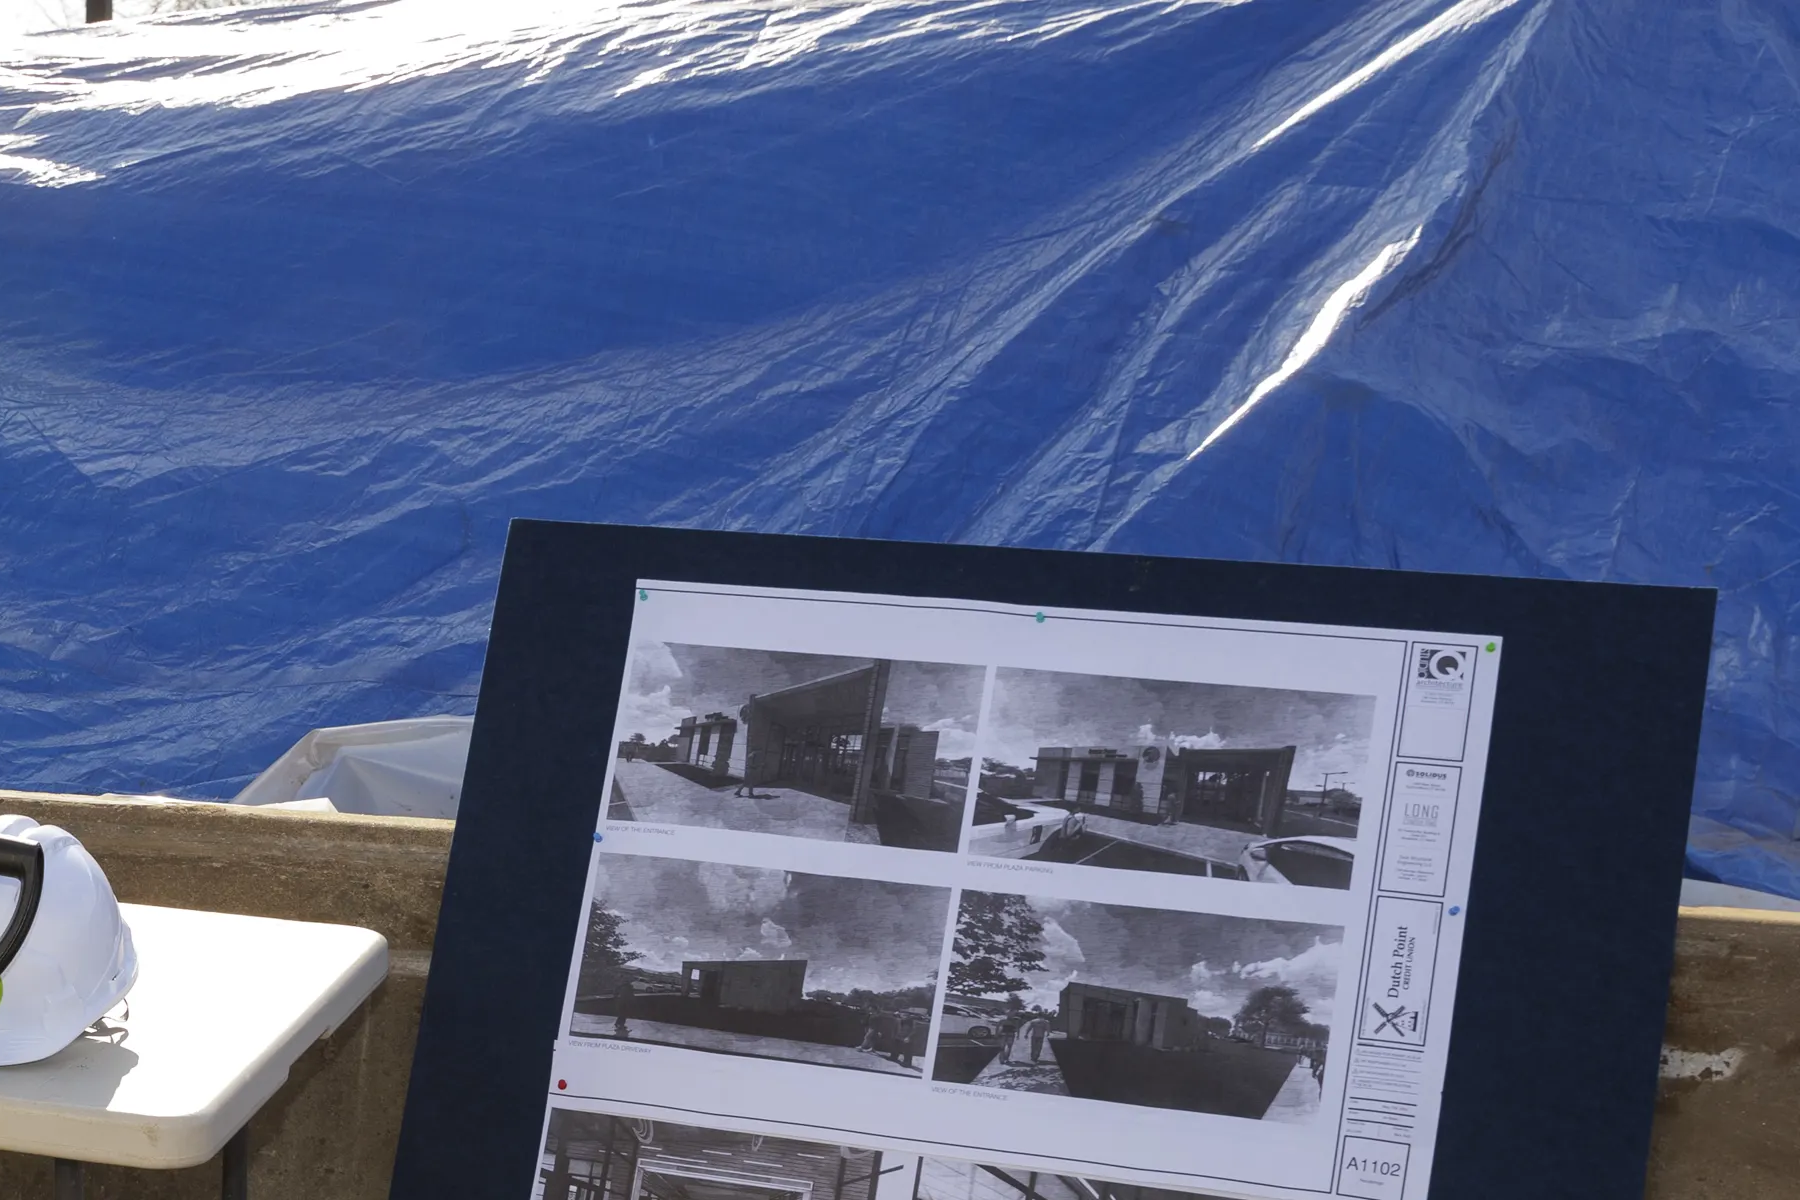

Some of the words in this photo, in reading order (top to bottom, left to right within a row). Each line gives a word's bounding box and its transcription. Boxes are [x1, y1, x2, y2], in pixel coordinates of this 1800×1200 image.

[1414, 771, 1448, 780] SOLIDUS
[1403, 803, 1440, 819] LONG
[643, 827, 676, 836] ENTRANCE
[1392, 925, 1409, 958] Point
[1407, 936, 1416, 963] UNION
[1387, 962, 1403, 998] Dutch
[1402, 963, 1413, 990] CREDIT
[1346, 1157, 1401, 1178] A1102
